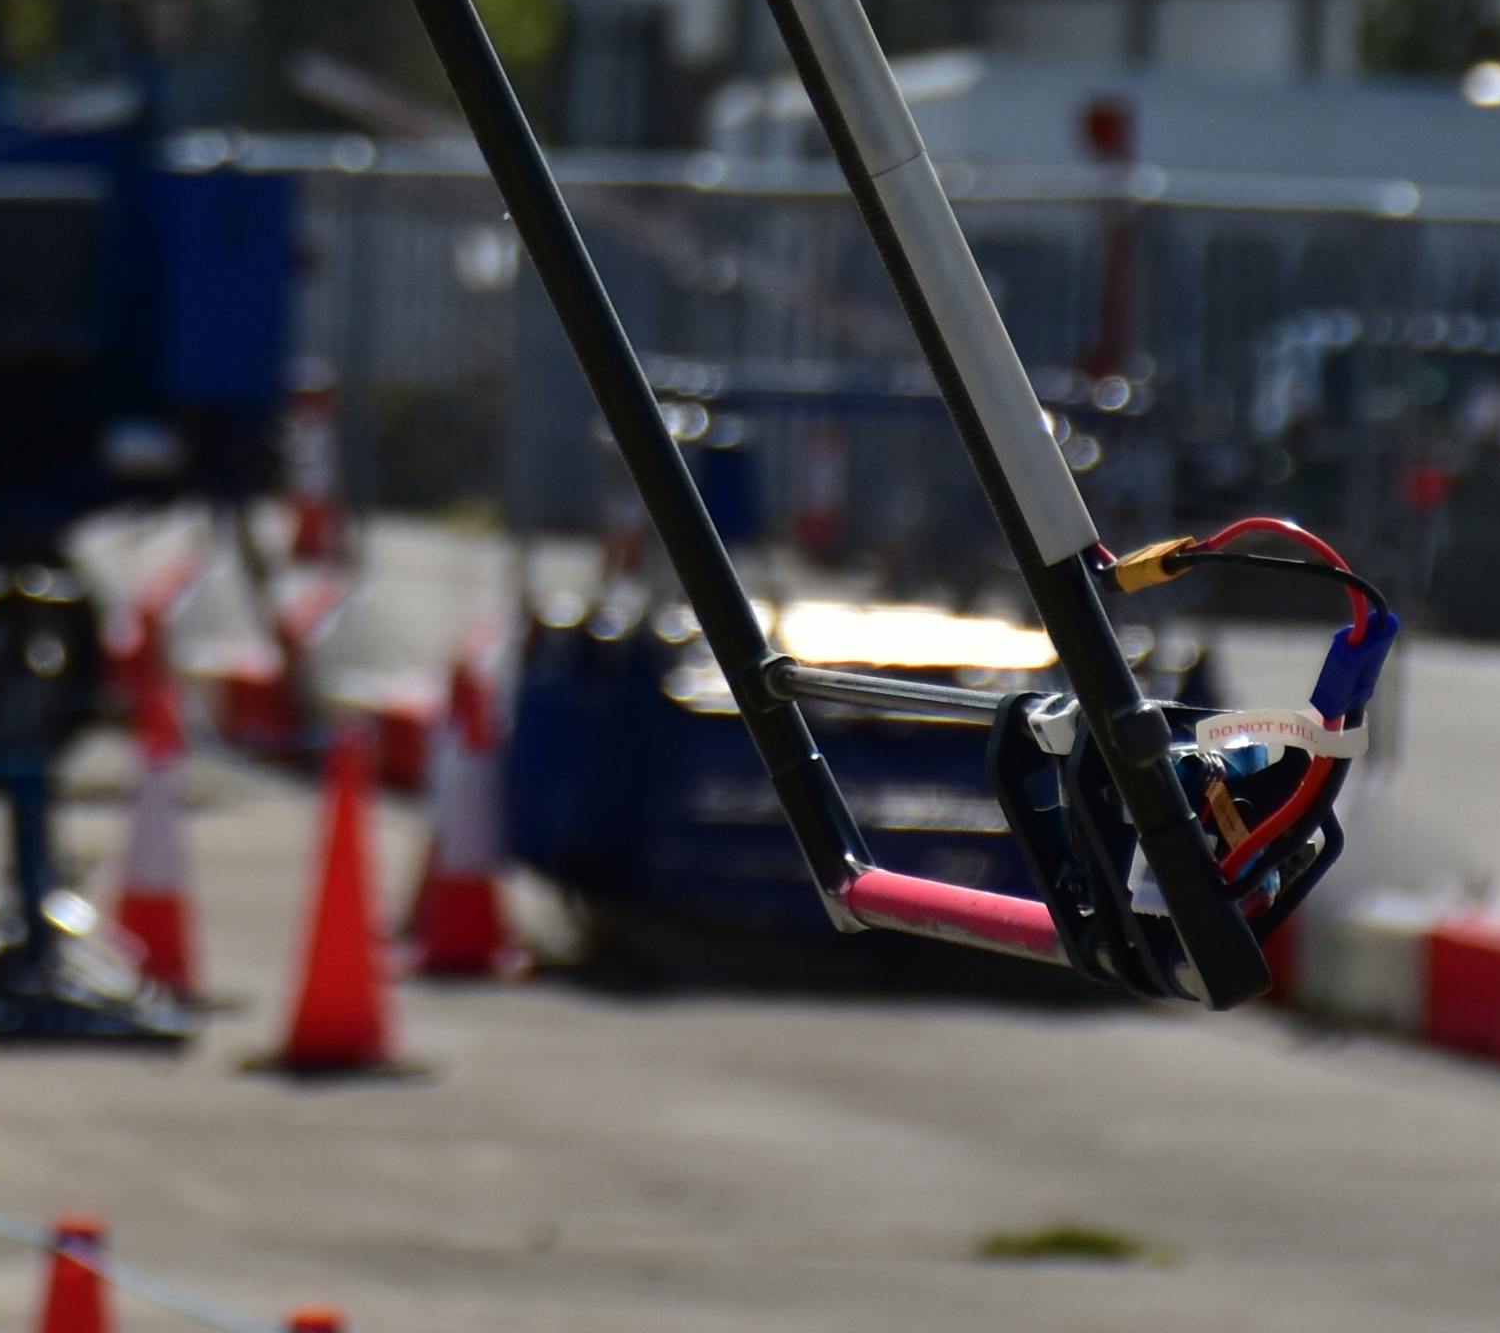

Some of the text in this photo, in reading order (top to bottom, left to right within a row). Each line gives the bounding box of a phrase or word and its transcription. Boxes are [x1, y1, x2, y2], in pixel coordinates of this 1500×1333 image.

[1208, 721, 1319, 743] DO NOT PULL
